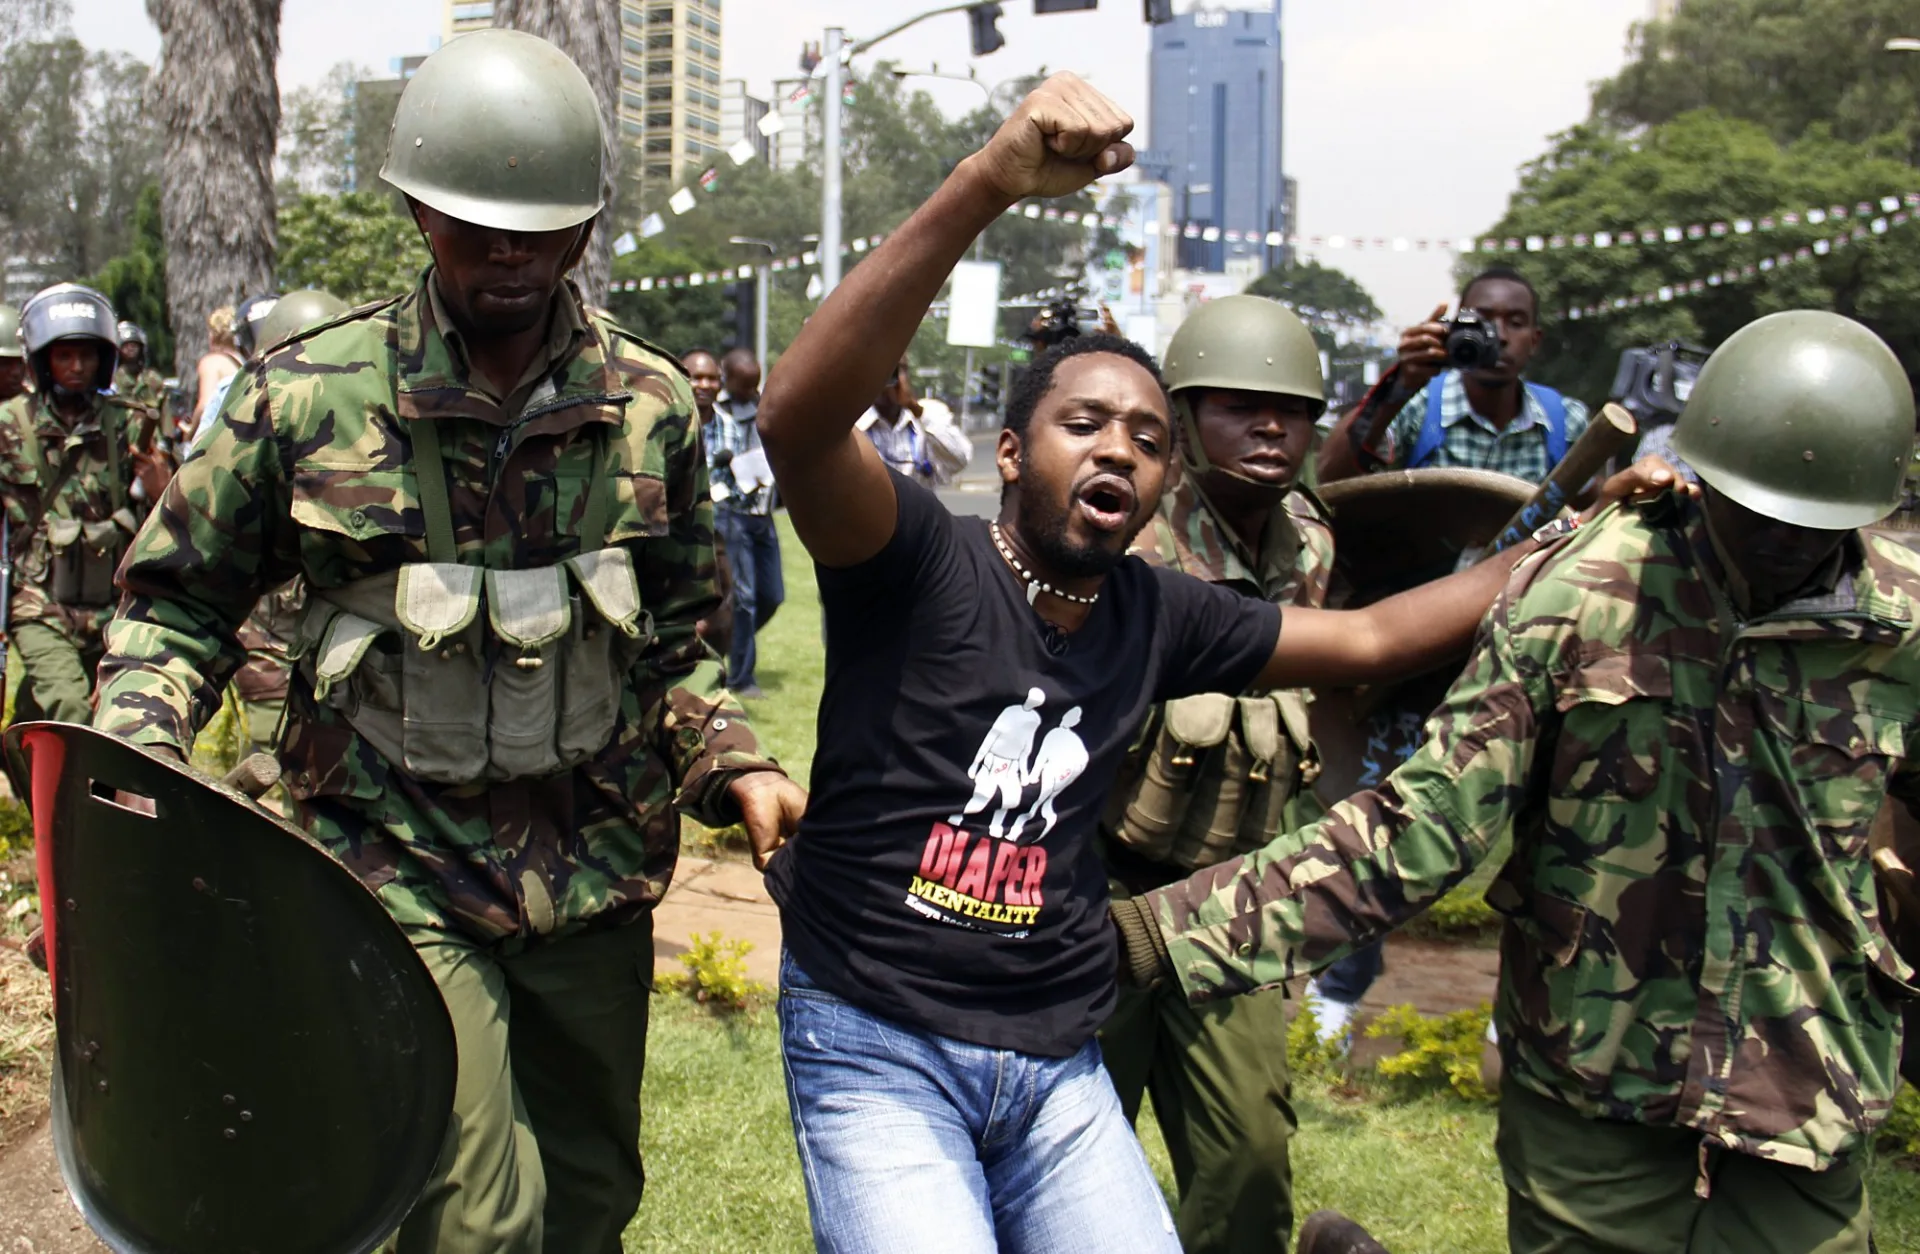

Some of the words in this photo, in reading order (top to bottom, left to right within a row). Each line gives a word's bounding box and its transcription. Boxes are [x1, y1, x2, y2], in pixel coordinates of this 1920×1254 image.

[918, 821, 1048, 907] DIAPER
[904, 894, 942, 921] Kenya
[908, 875, 1041, 925] MENTALITY
